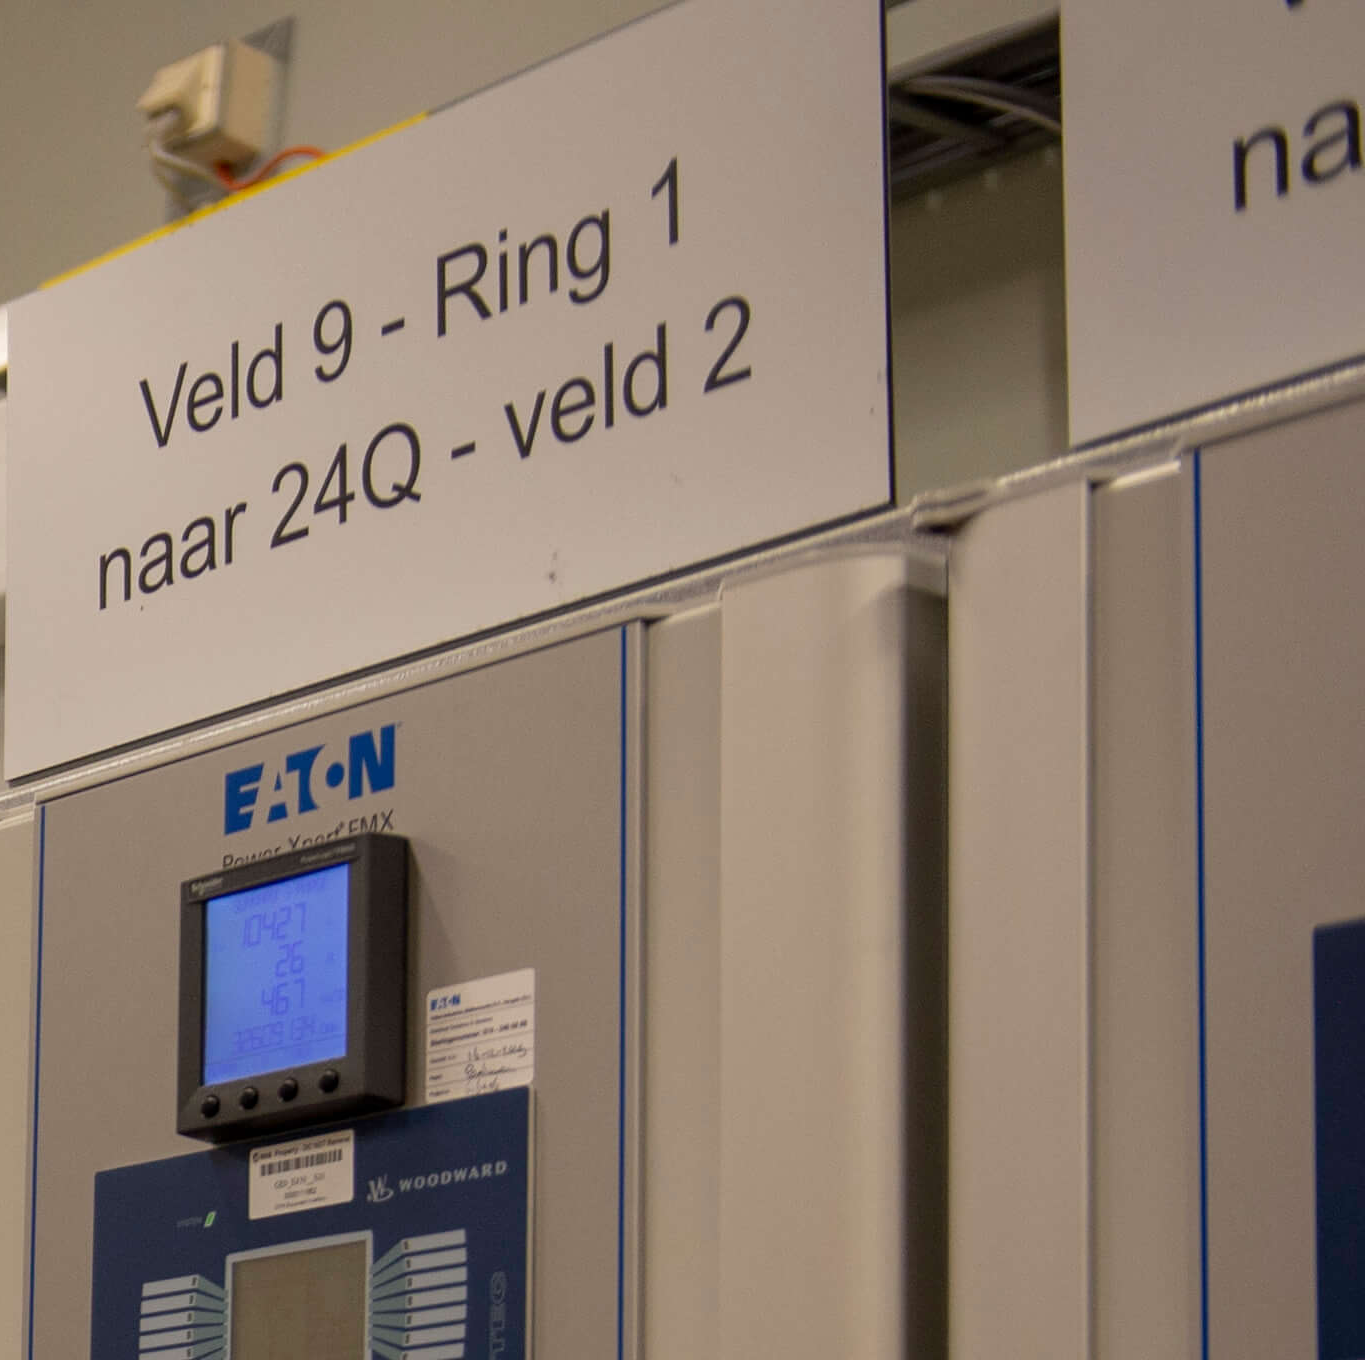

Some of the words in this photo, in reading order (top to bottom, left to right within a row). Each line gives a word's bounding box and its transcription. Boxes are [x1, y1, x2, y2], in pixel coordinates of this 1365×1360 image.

[140, 324, 285, 449] Veld
[313, 301, 354, 383] 9
[381, 315, 406, 338] -
[436, 208, 611, 337] Ring
[651, 157, 681, 245] 1
[98, 501, 247, 610] naar
[270, 422, 422, 550] 24Q
[451, 443, 477, 464] -
[504, 323, 668, 459] veld
[703, 295, 752, 394] 2
[224, 722, 396, 835] EATON
[348, 809, 395, 835] FMX
[399, 1160, 508, 1192] WOODWARD
